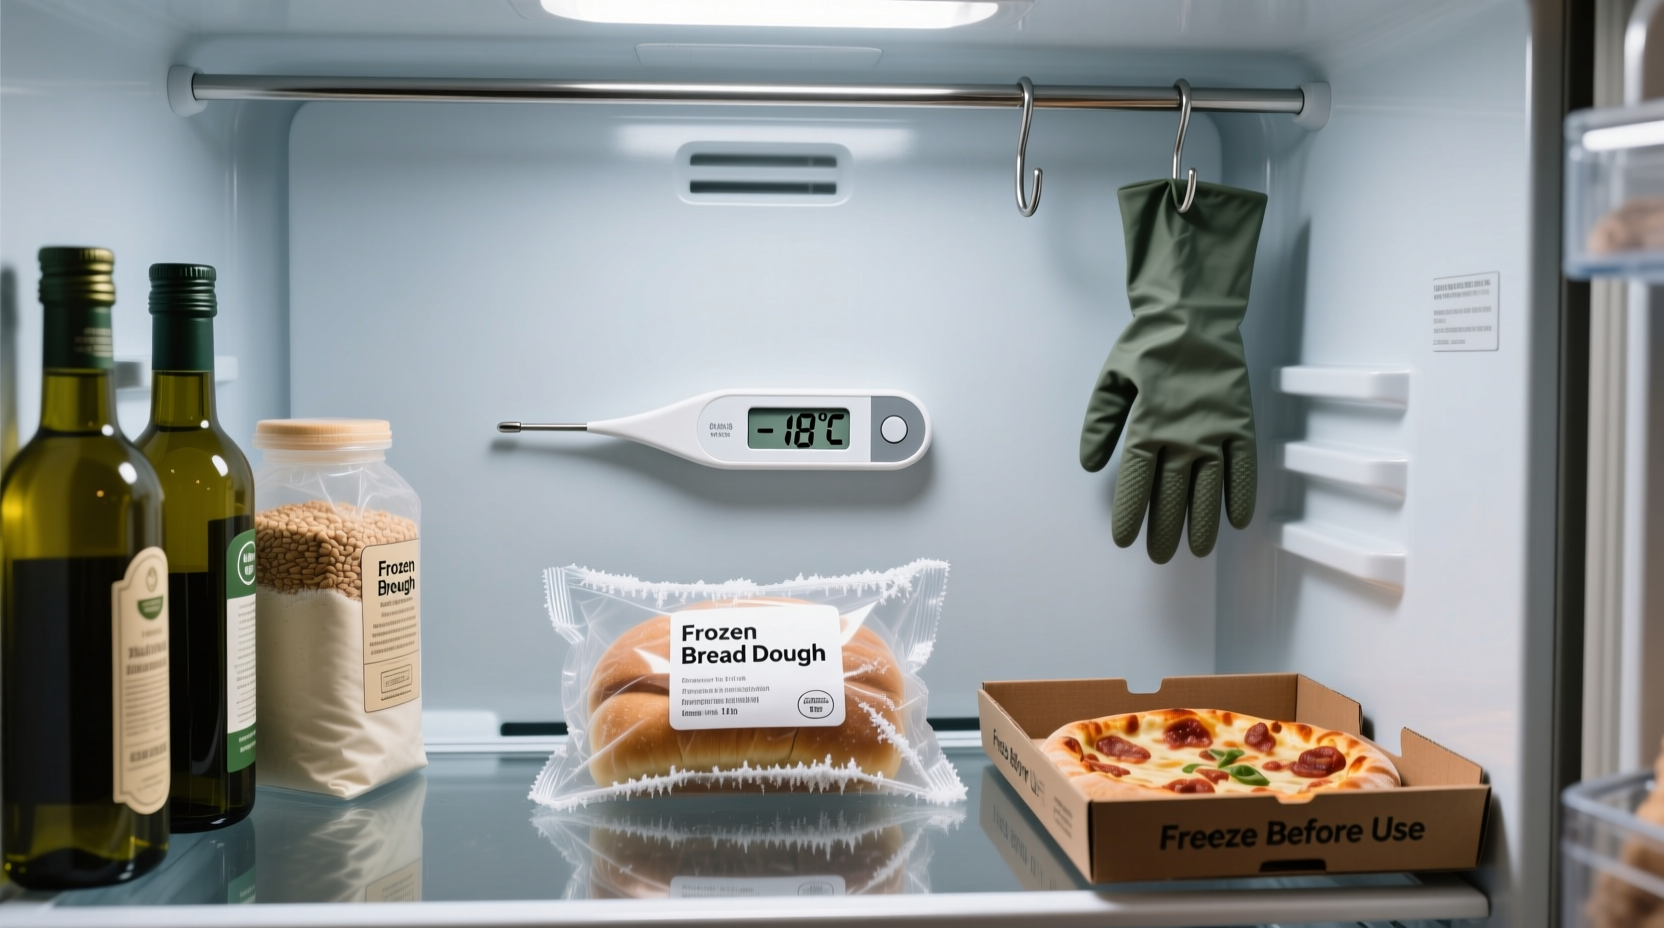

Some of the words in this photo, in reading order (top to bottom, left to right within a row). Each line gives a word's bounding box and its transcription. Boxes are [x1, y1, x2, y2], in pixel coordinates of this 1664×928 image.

[757, 412, 845, 448] -18°C
[378, 560, 415, 577] Frozen
[682, 624, 757, 642] Frozen
[681, 644, 746, 665] Bread
[753, 643, 826, 667] Dough
[1159, 823, 1258, 850] Freeze
[1266, 818, 1364, 846] Before
[1372, 816, 1426, 842] Use
